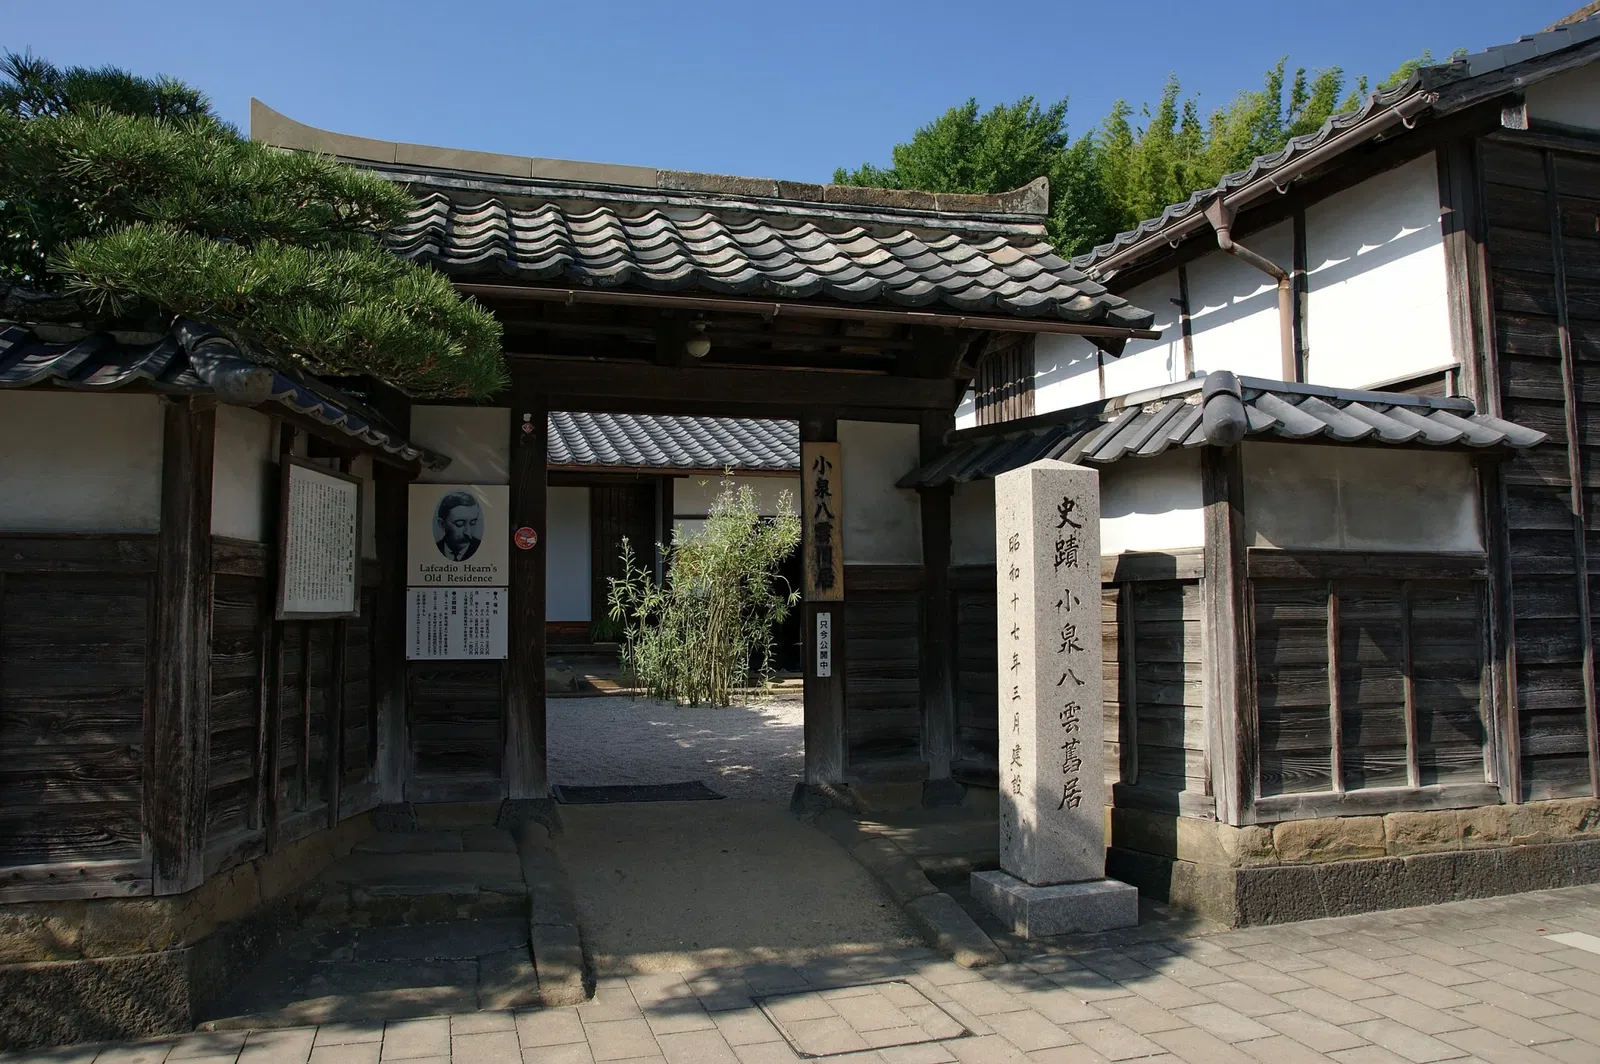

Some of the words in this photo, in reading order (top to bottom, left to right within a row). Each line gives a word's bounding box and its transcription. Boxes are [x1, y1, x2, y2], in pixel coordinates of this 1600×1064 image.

[420, 564, 459, 573] Lafcadio
[463, 563, 498, 573] Hearn's
[424, 574, 442, 583] Old
[447, 574, 493, 583] Residence
[819, 620, 829, 669] 只今公開中
